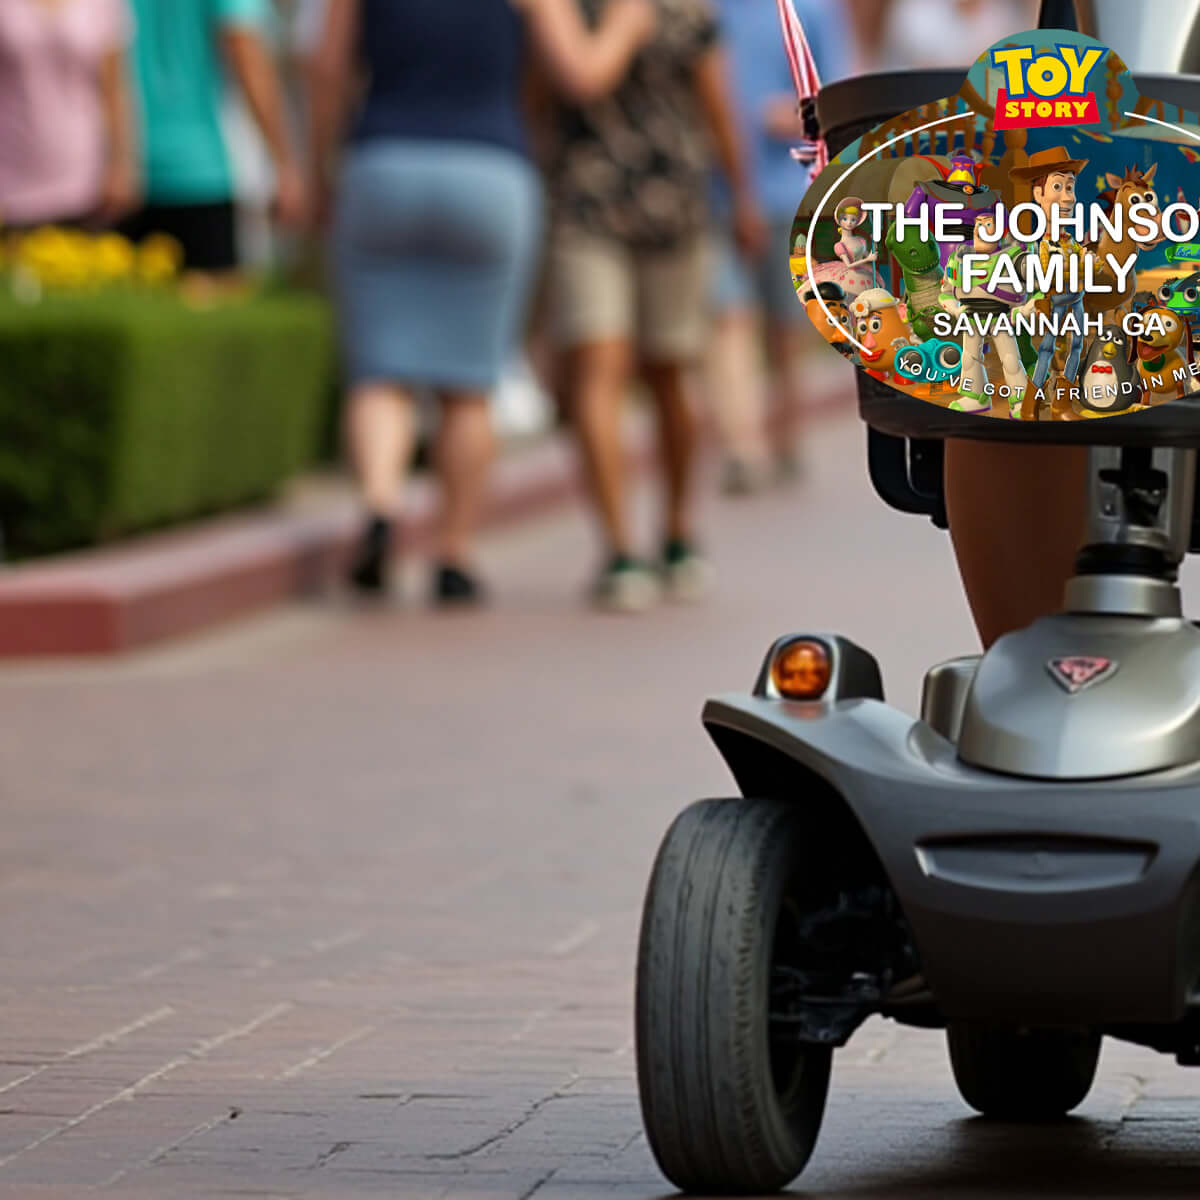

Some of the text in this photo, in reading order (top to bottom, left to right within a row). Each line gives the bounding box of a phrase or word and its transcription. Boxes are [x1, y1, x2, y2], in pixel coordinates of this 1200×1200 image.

[992, 45, 1107, 98] TOY
[1005, 101, 1090, 118] STORY
[861, 202, 965, 243] THE
[961, 254, 1137, 294] FAMILY
[933, 313, 1166, 340] SAVANNAH, GA
[898, 357, 973, 392] YOU'VE
[984, 383, 1025, 399] GOT
[1034, 389, 1046, 401] A
[1056, 382, 1133, 401] FRIEND
[1142, 376, 1165, 392] IN
